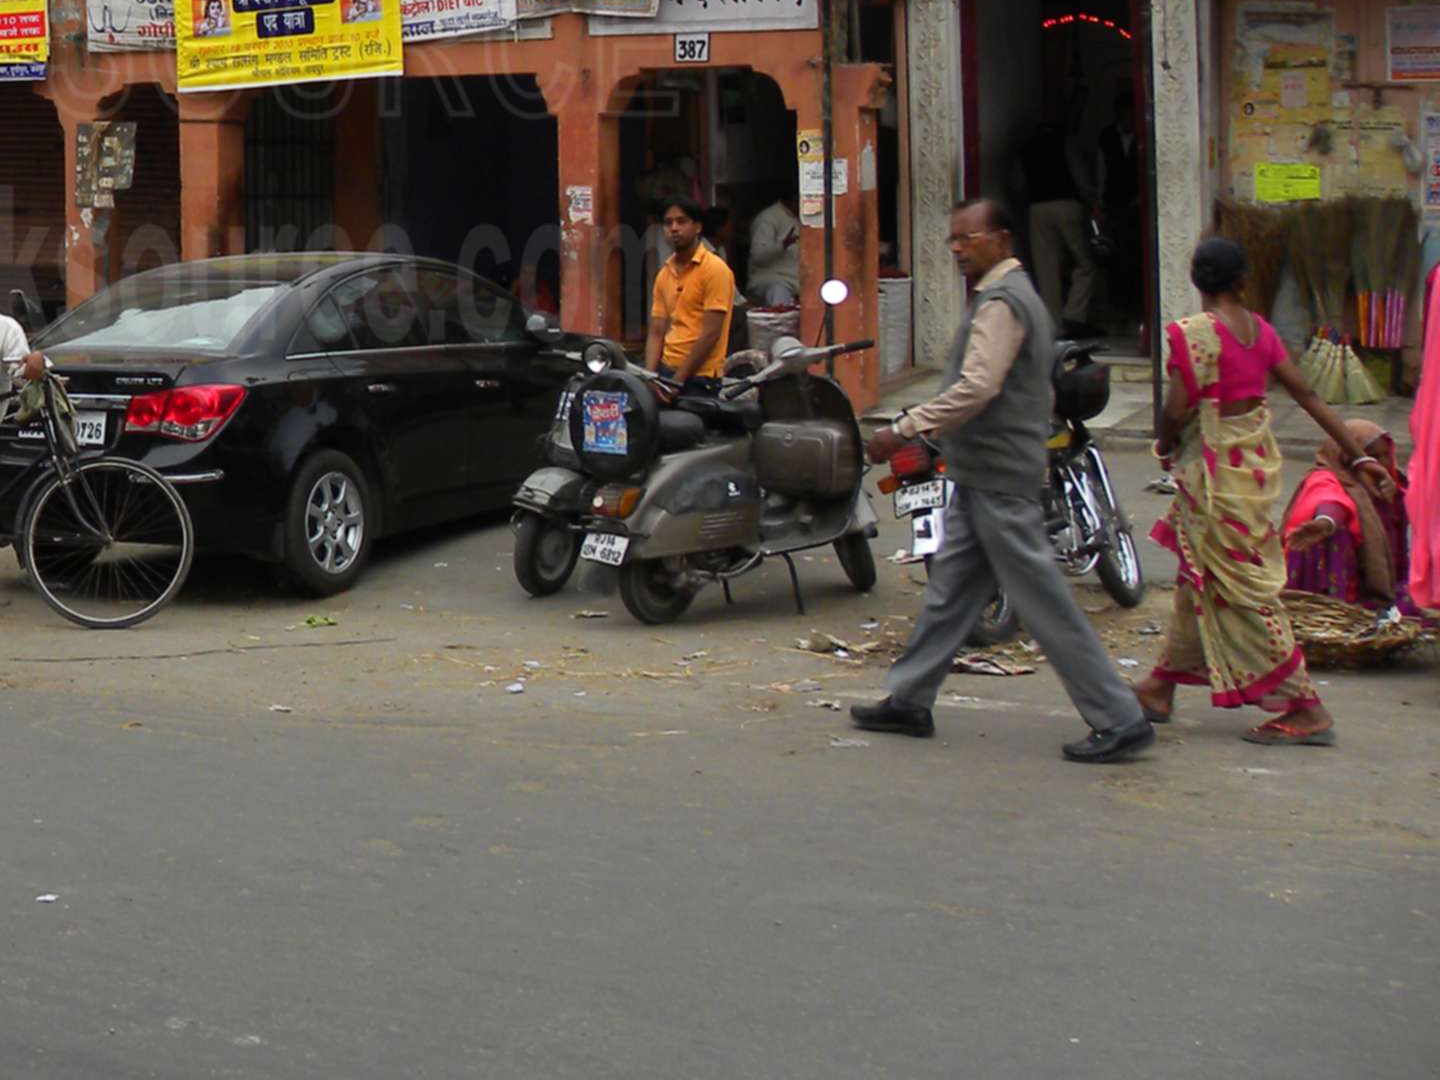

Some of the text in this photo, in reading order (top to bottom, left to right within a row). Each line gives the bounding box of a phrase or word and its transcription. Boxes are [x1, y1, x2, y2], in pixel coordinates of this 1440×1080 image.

[263, 9, 307, 33] पद यात्रा
[298, 44, 328, 63] समिति
[678, 40, 706, 59] 387
[75, 420, 102, 440] 726
